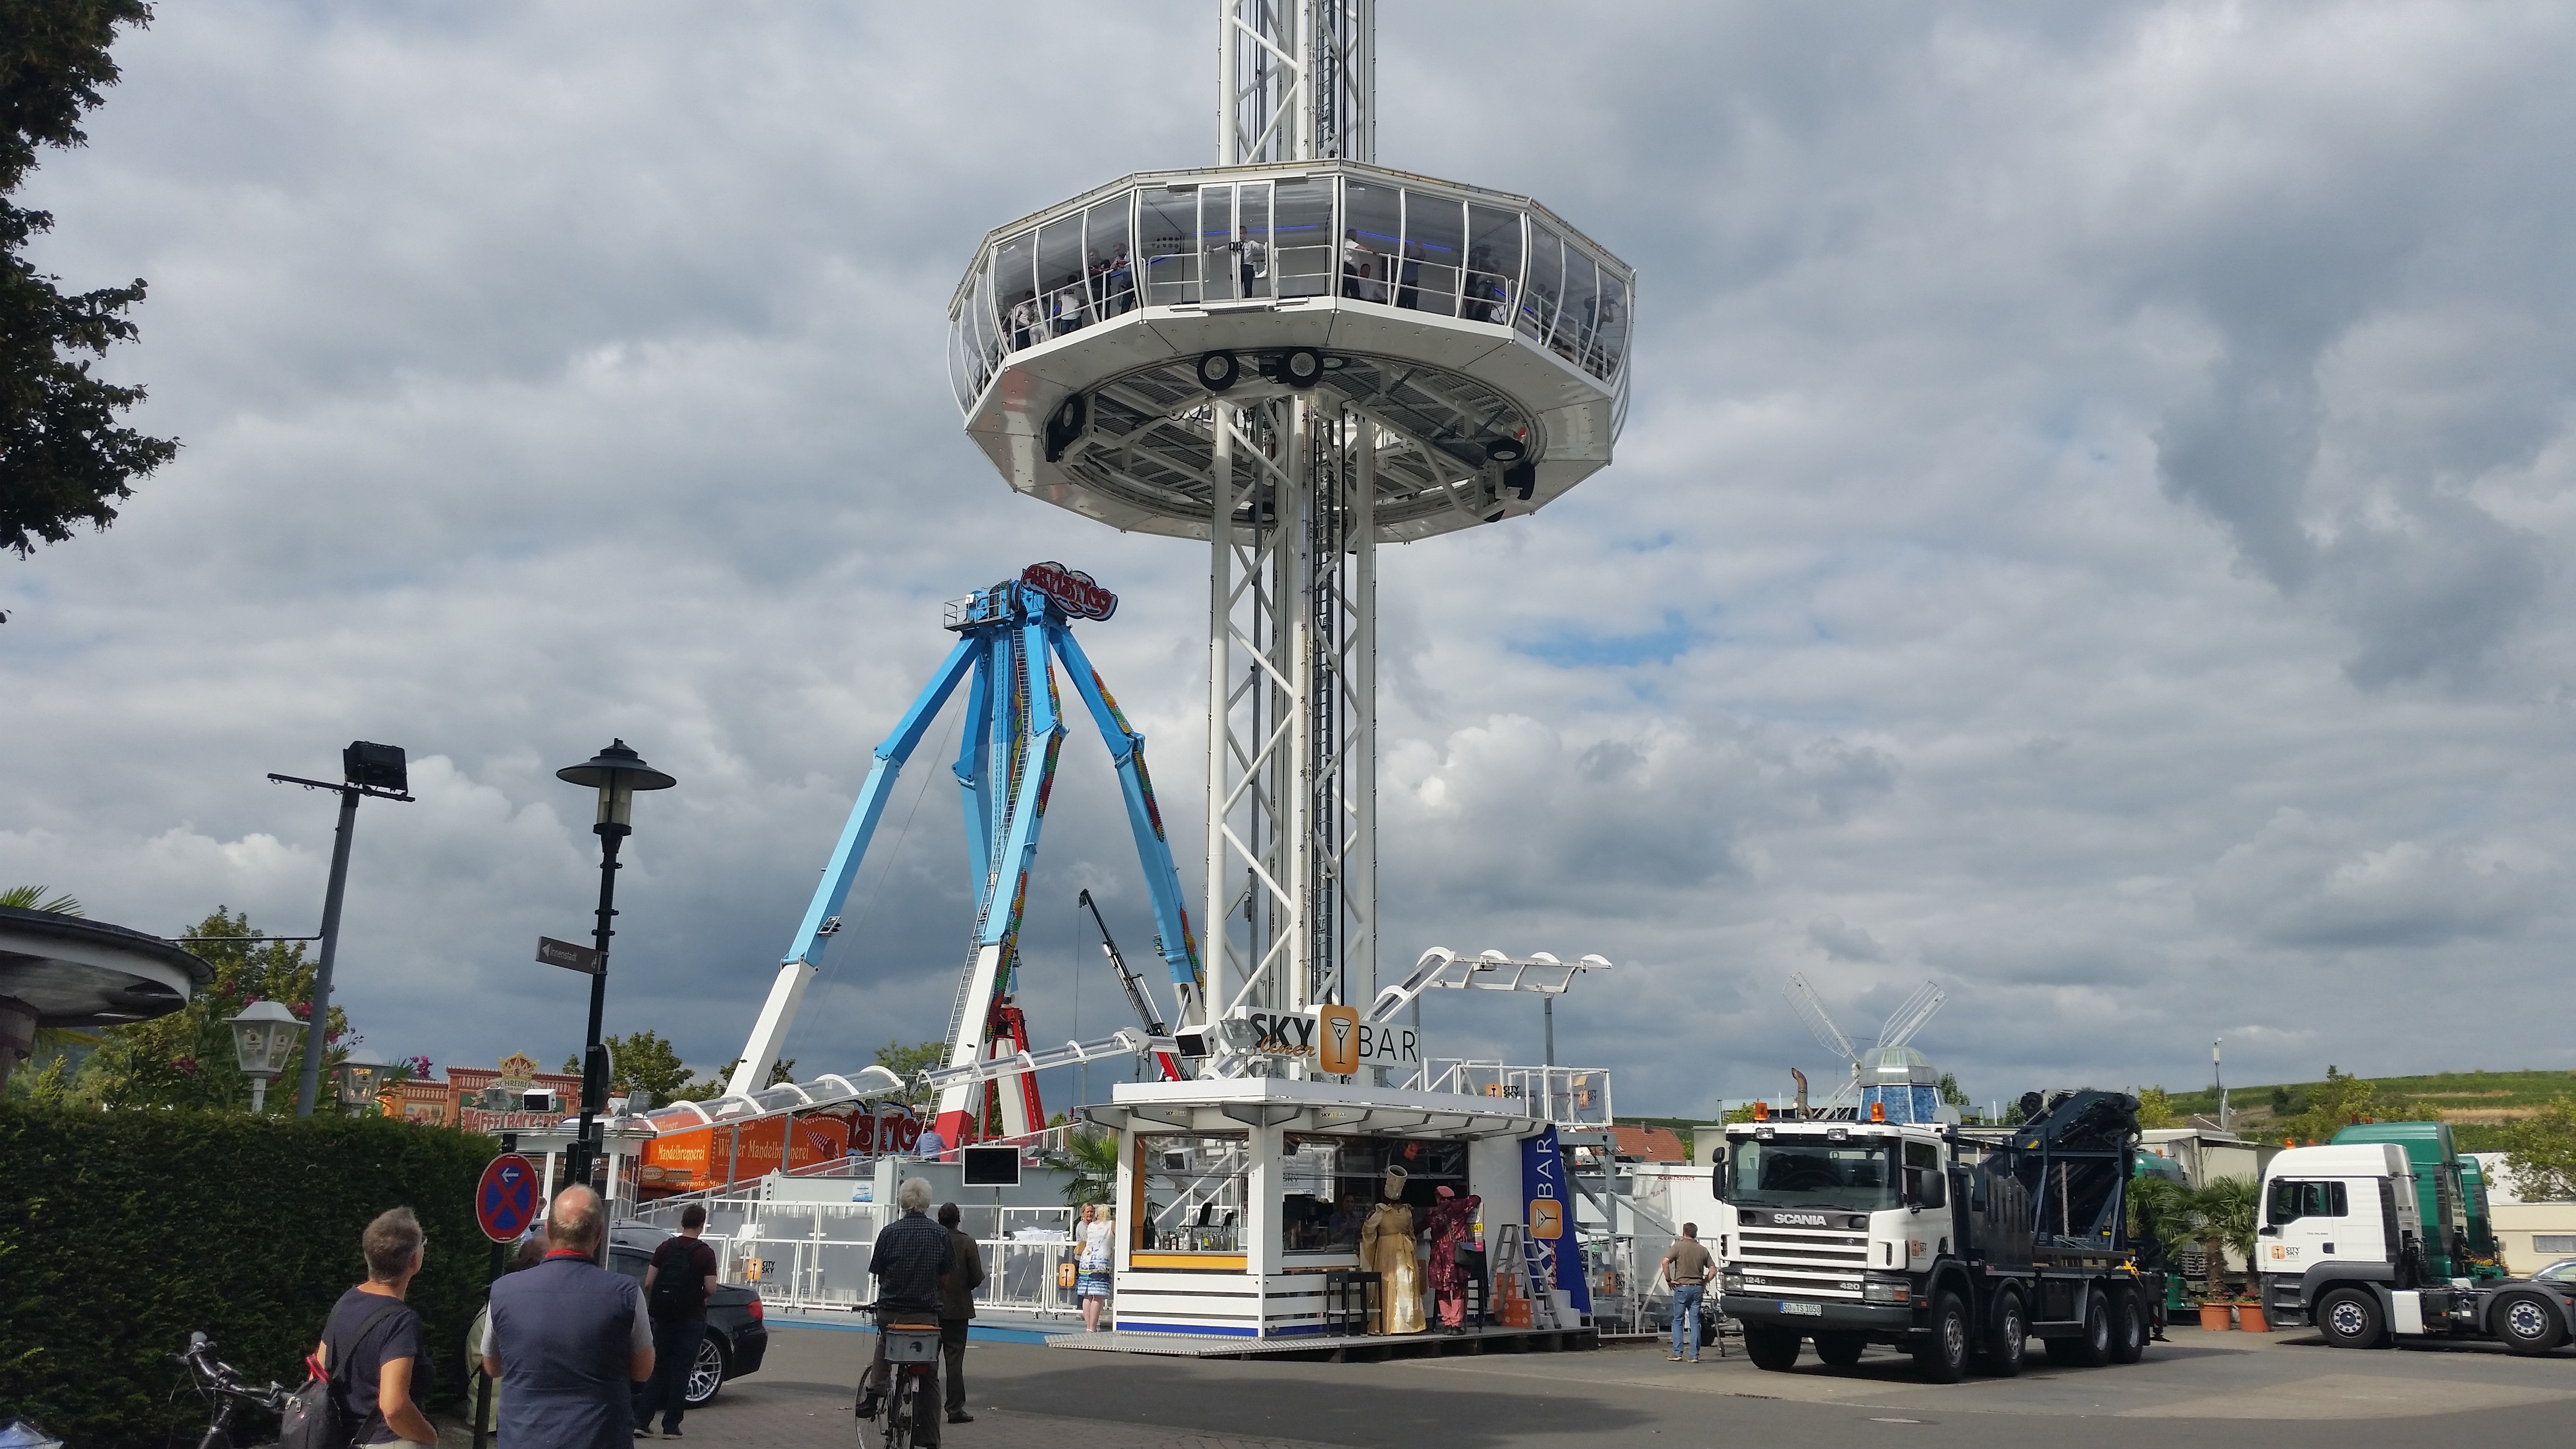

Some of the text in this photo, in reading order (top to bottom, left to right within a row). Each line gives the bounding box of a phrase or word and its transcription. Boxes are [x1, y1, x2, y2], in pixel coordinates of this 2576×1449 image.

[550, 947, 577, 962] Innenstadt
[1250, 1013, 1417, 1063] SKY BAR
[1260, 1034, 1316, 1057] liner
[658, 1121, 678, 1132] Wiener
[657, 1144, 705, 1162] Mandelbrennerei
[1537, 1137, 1553, 1198] BAR
[1774, 1213, 1827, 1225] SCANIA
[1839, 1282, 1860, 1290] 420
[1796, 1304, 1804, 1312] TS
[1805, 1305, 1821, 1313] 1058
